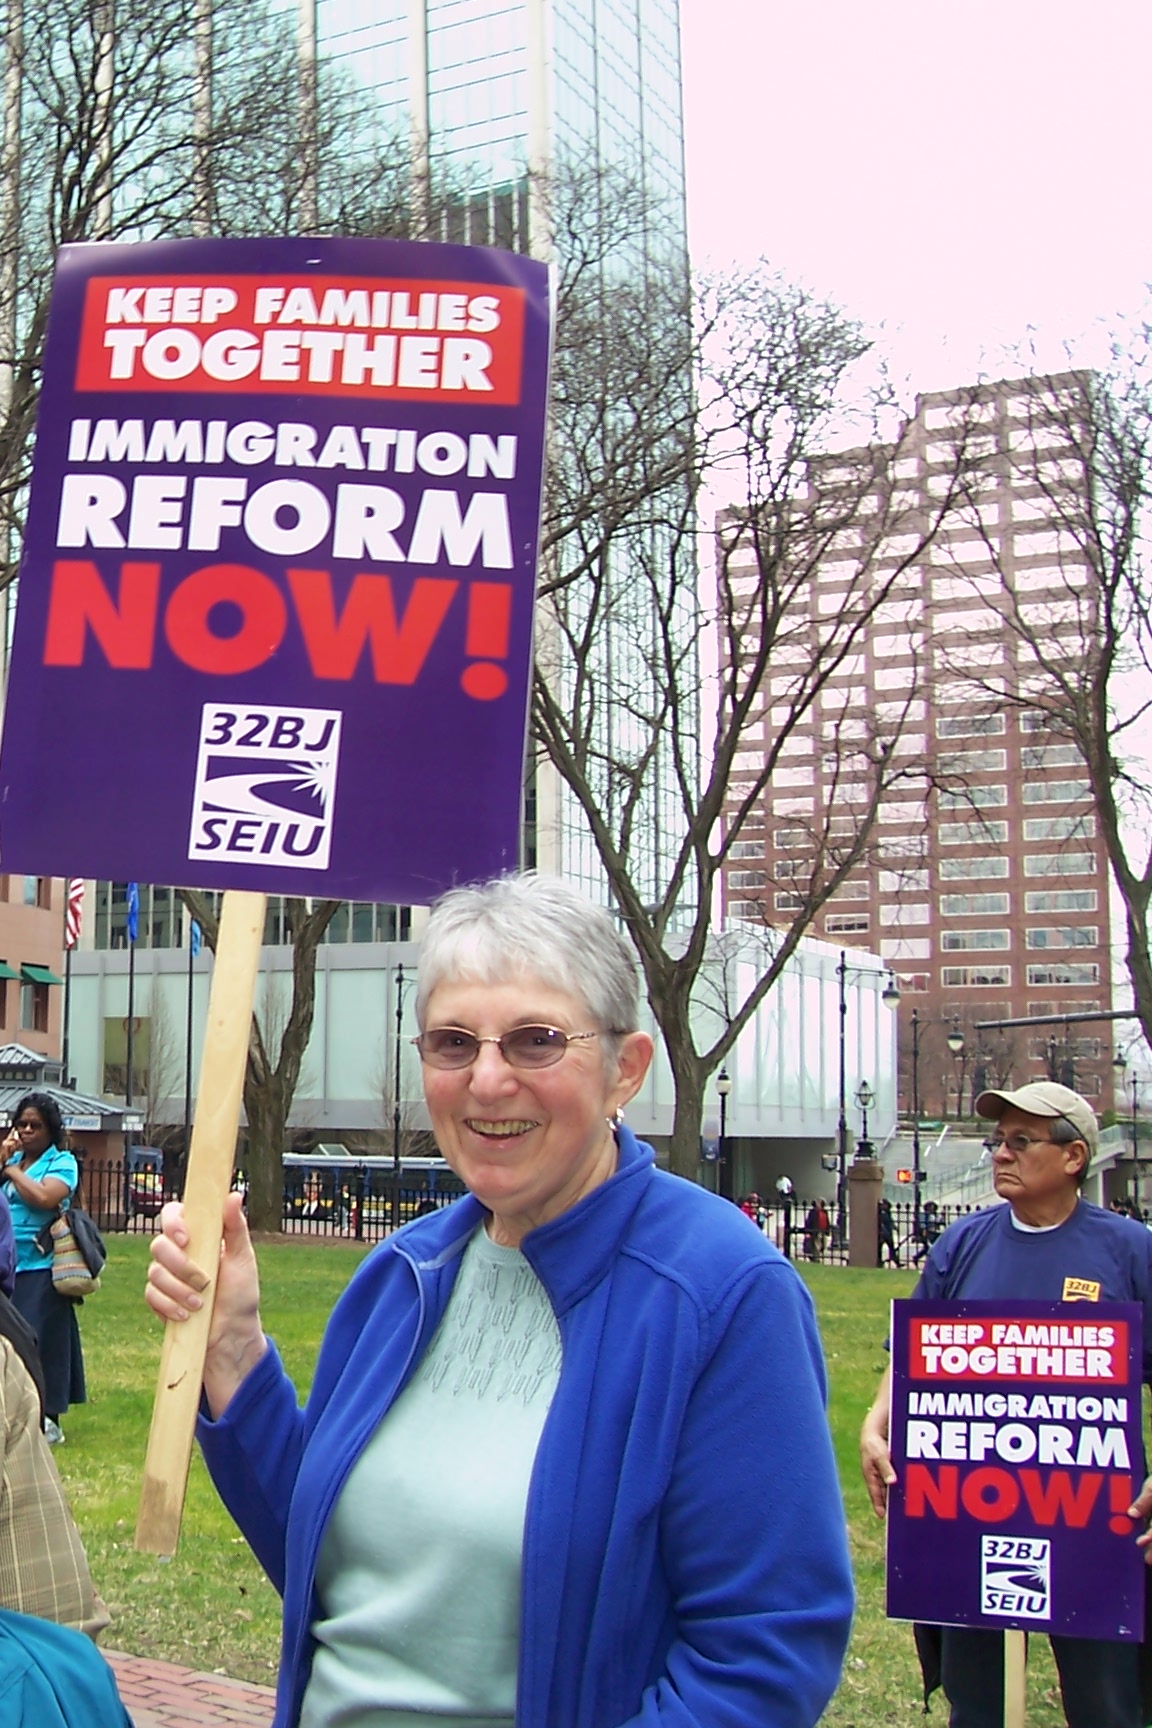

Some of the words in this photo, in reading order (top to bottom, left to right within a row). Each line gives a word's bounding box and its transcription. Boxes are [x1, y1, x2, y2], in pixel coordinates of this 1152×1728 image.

[105, 287, 238, 324] KEEP
[254, 288, 501, 333] FAMILIES
[103, 328, 493, 391] TOGETHER
[68, 419, 517, 479] IMMIGRATION
[56, 474, 514, 569] REFORM
[43, 560, 512, 700] NOW!
[204, 712, 336, 752] 32BJ
[195, 818, 326, 857] SEIU
[921, 1324, 984, 1345] KEEP
[992, 1324, 1115, 1347] FAMILIES
[921, 1346, 1114, 1378] TOGETHER
[908, 1392, 1127, 1422] IMMIGRATION
[906, 1420, 1131, 1469] REFORM
[905, 1463, 1133, 1536] NOW!
[984, 1539, 1048, 1561] 32BJ
[984, 1593, 1046, 1613] SEIU
